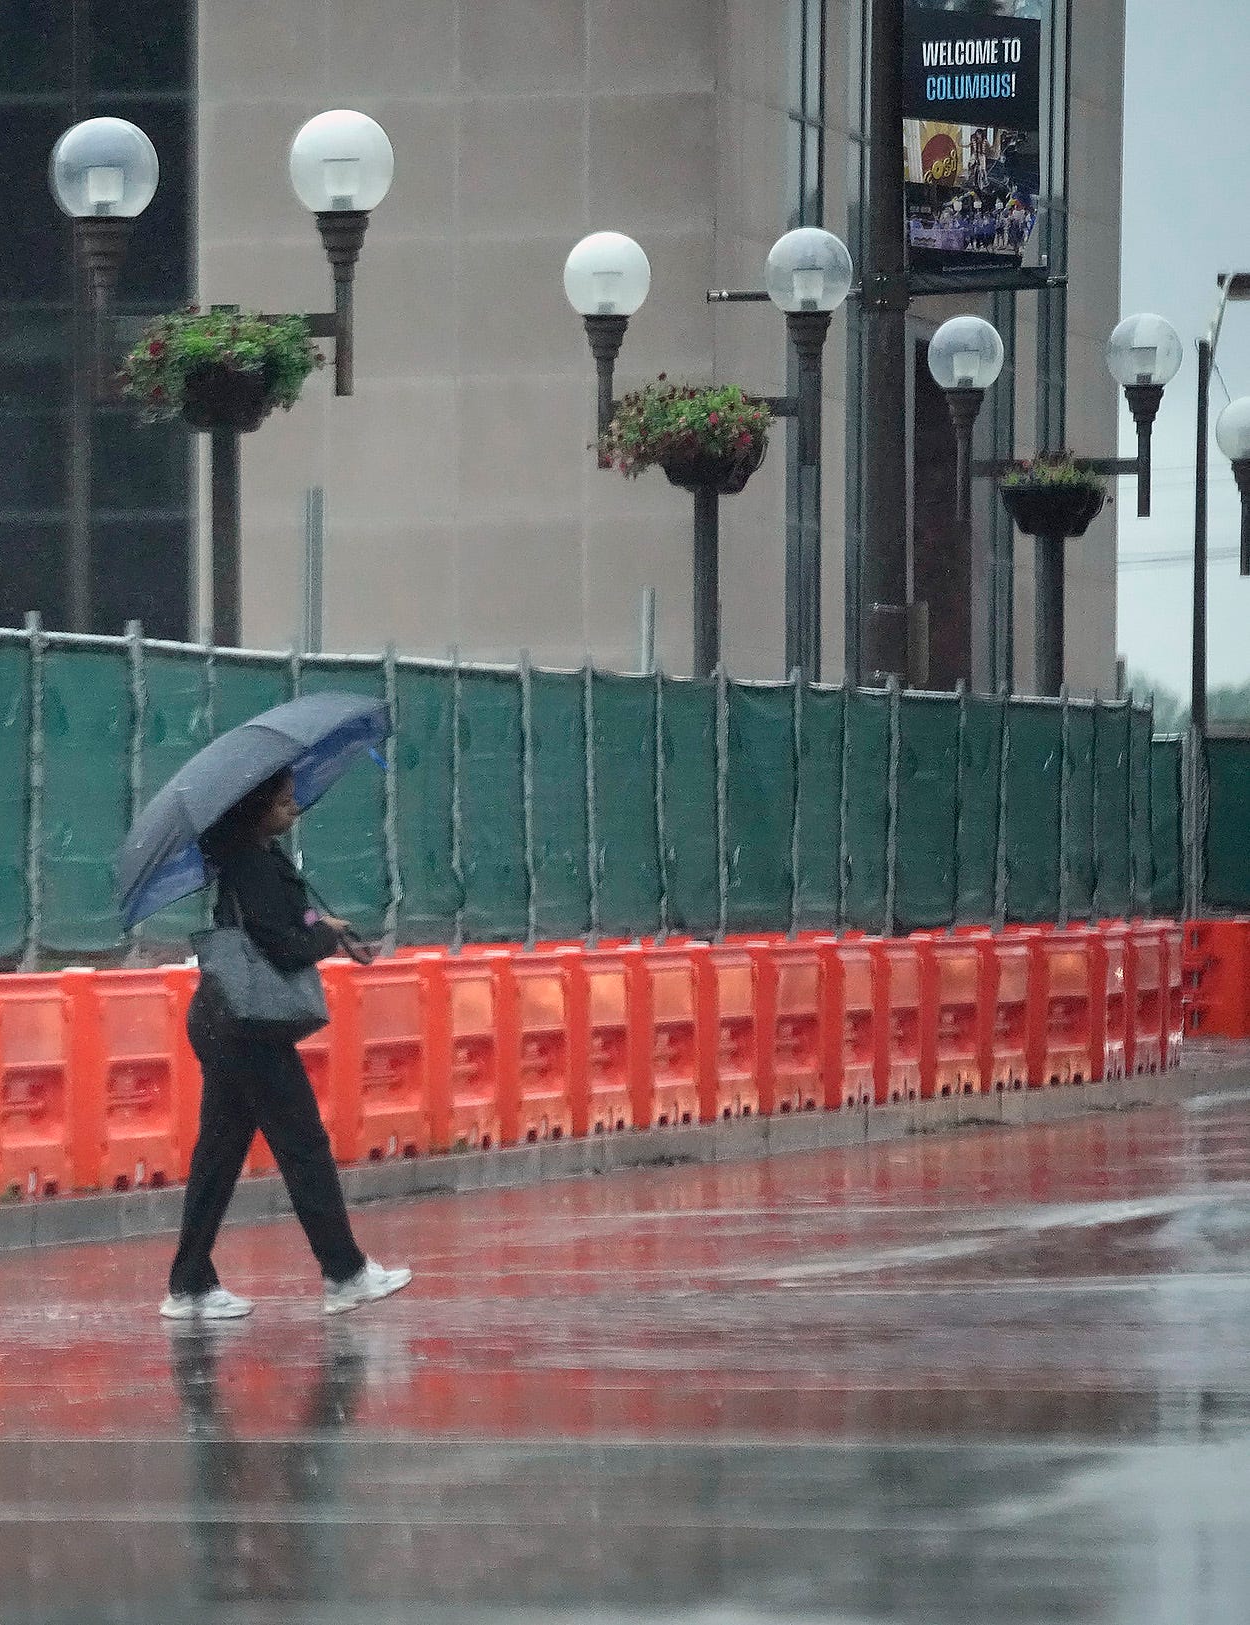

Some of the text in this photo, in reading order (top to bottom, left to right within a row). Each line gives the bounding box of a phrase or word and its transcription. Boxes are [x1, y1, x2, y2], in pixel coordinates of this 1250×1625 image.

[922, 37, 1021, 67] WELCOME TO
[926, 72, 1016, 101] COLUMBUS!
